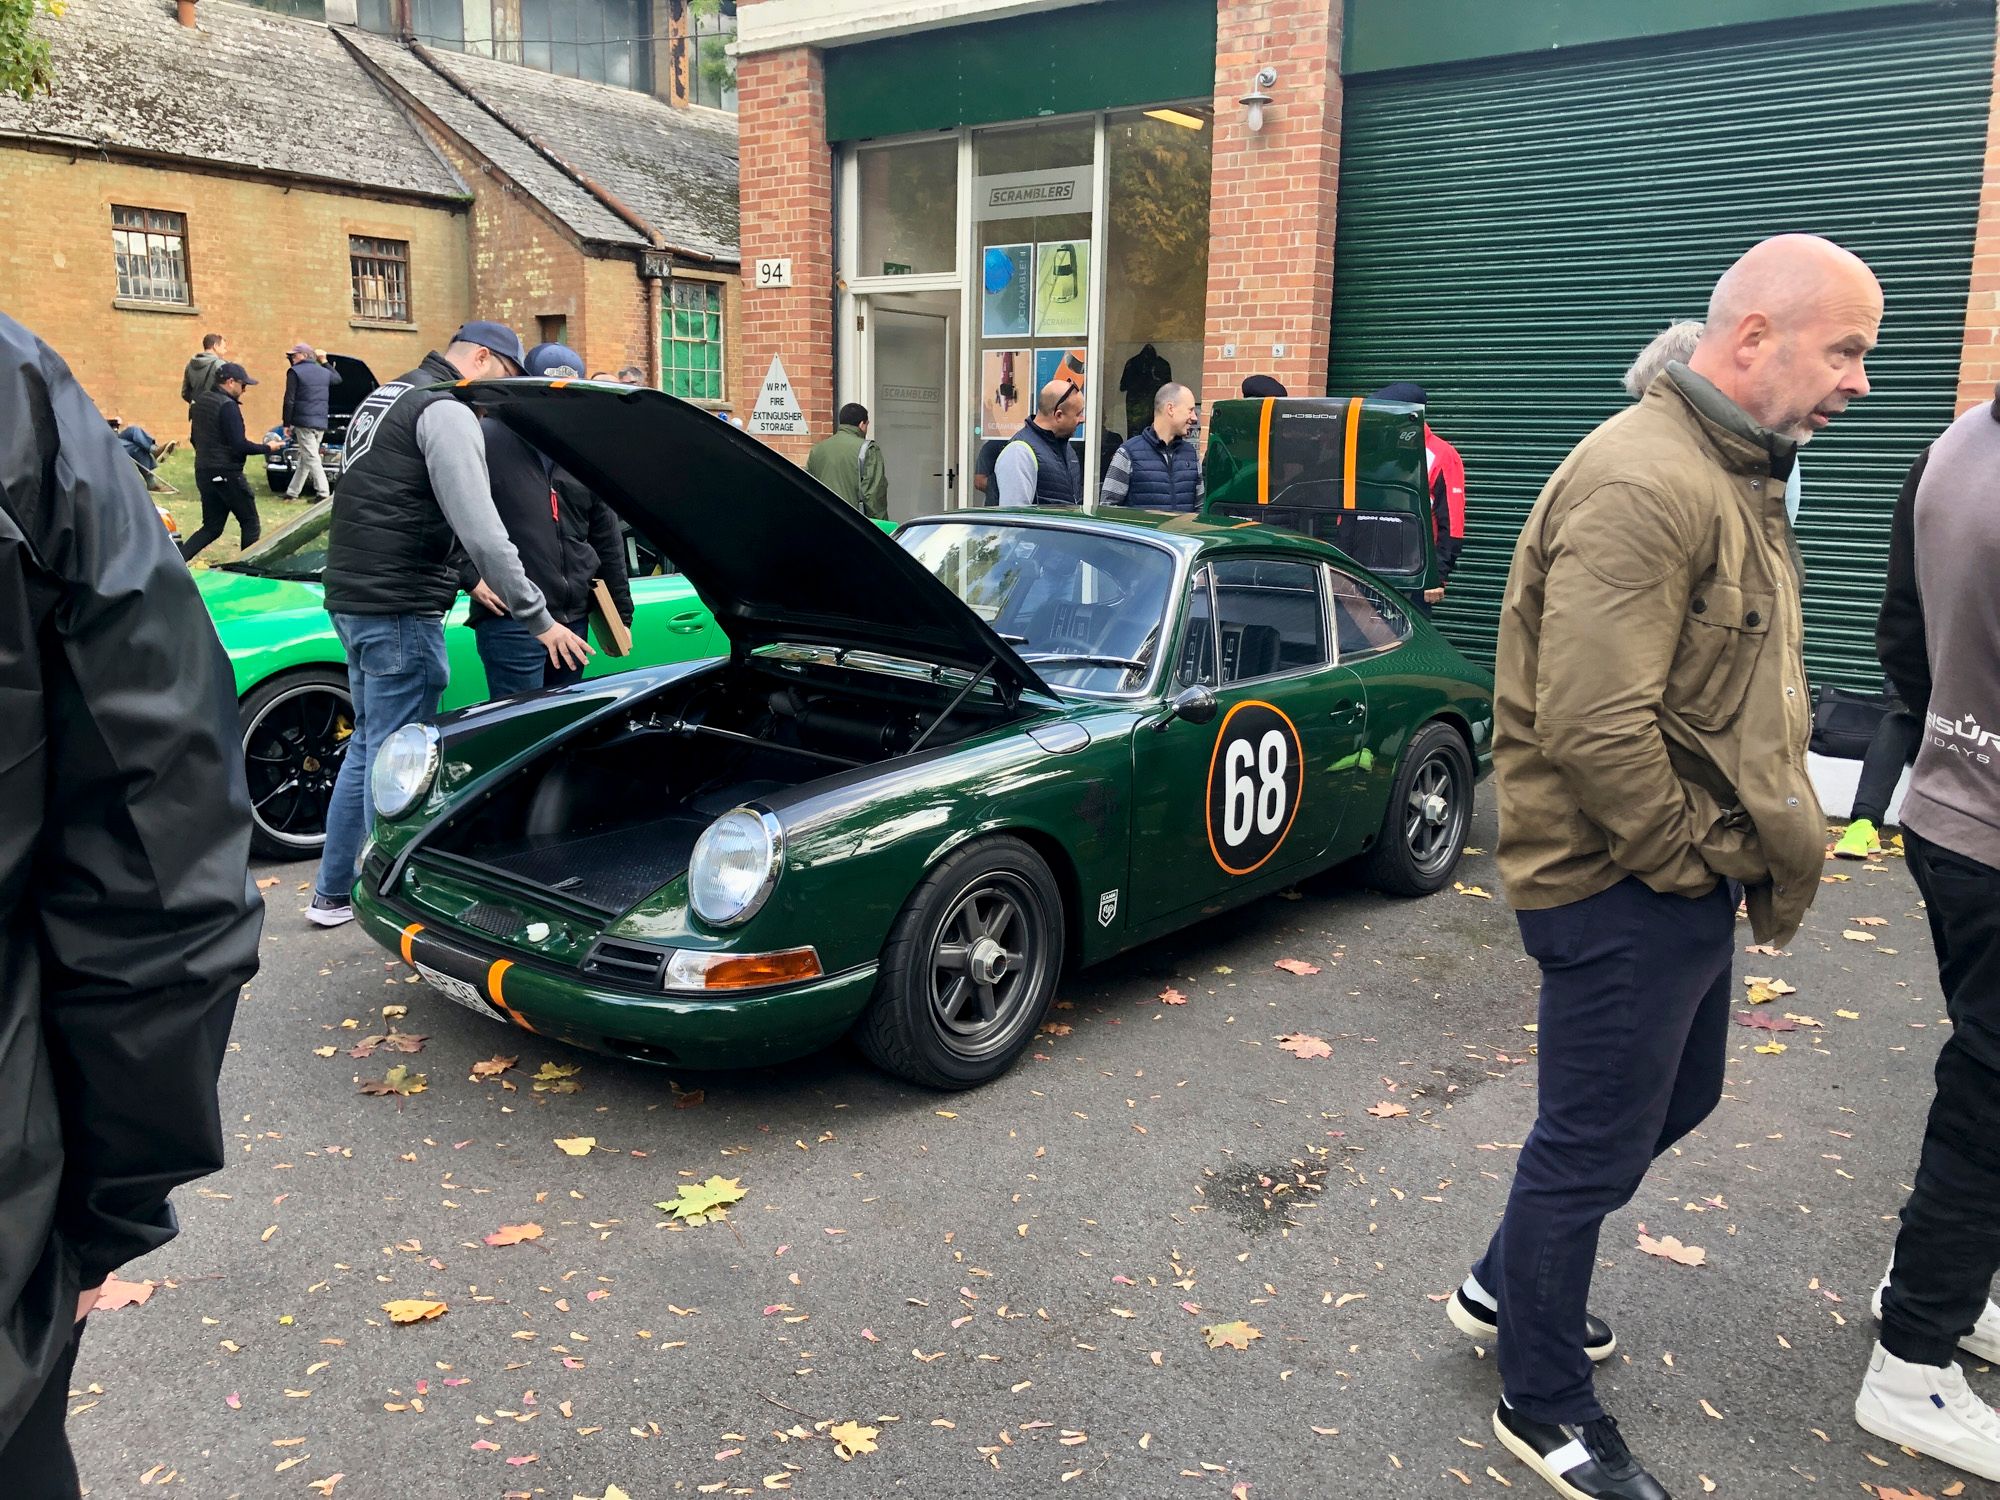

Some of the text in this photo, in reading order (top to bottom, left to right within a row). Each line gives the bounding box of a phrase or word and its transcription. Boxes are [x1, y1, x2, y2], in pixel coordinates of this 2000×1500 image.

[992, 184, 1071, 203] SCRAMBLERS
[761, 263, 783, 284] 94
[883, 387, 938, 401] SCRAMBLERS
[769, 397, 785, 406] FIRE
[753, 411, 803, 422] EXTINGUISHER
[760, 422, 794, 432] STORAGE
[1223, 729, 1288, 847] 68
